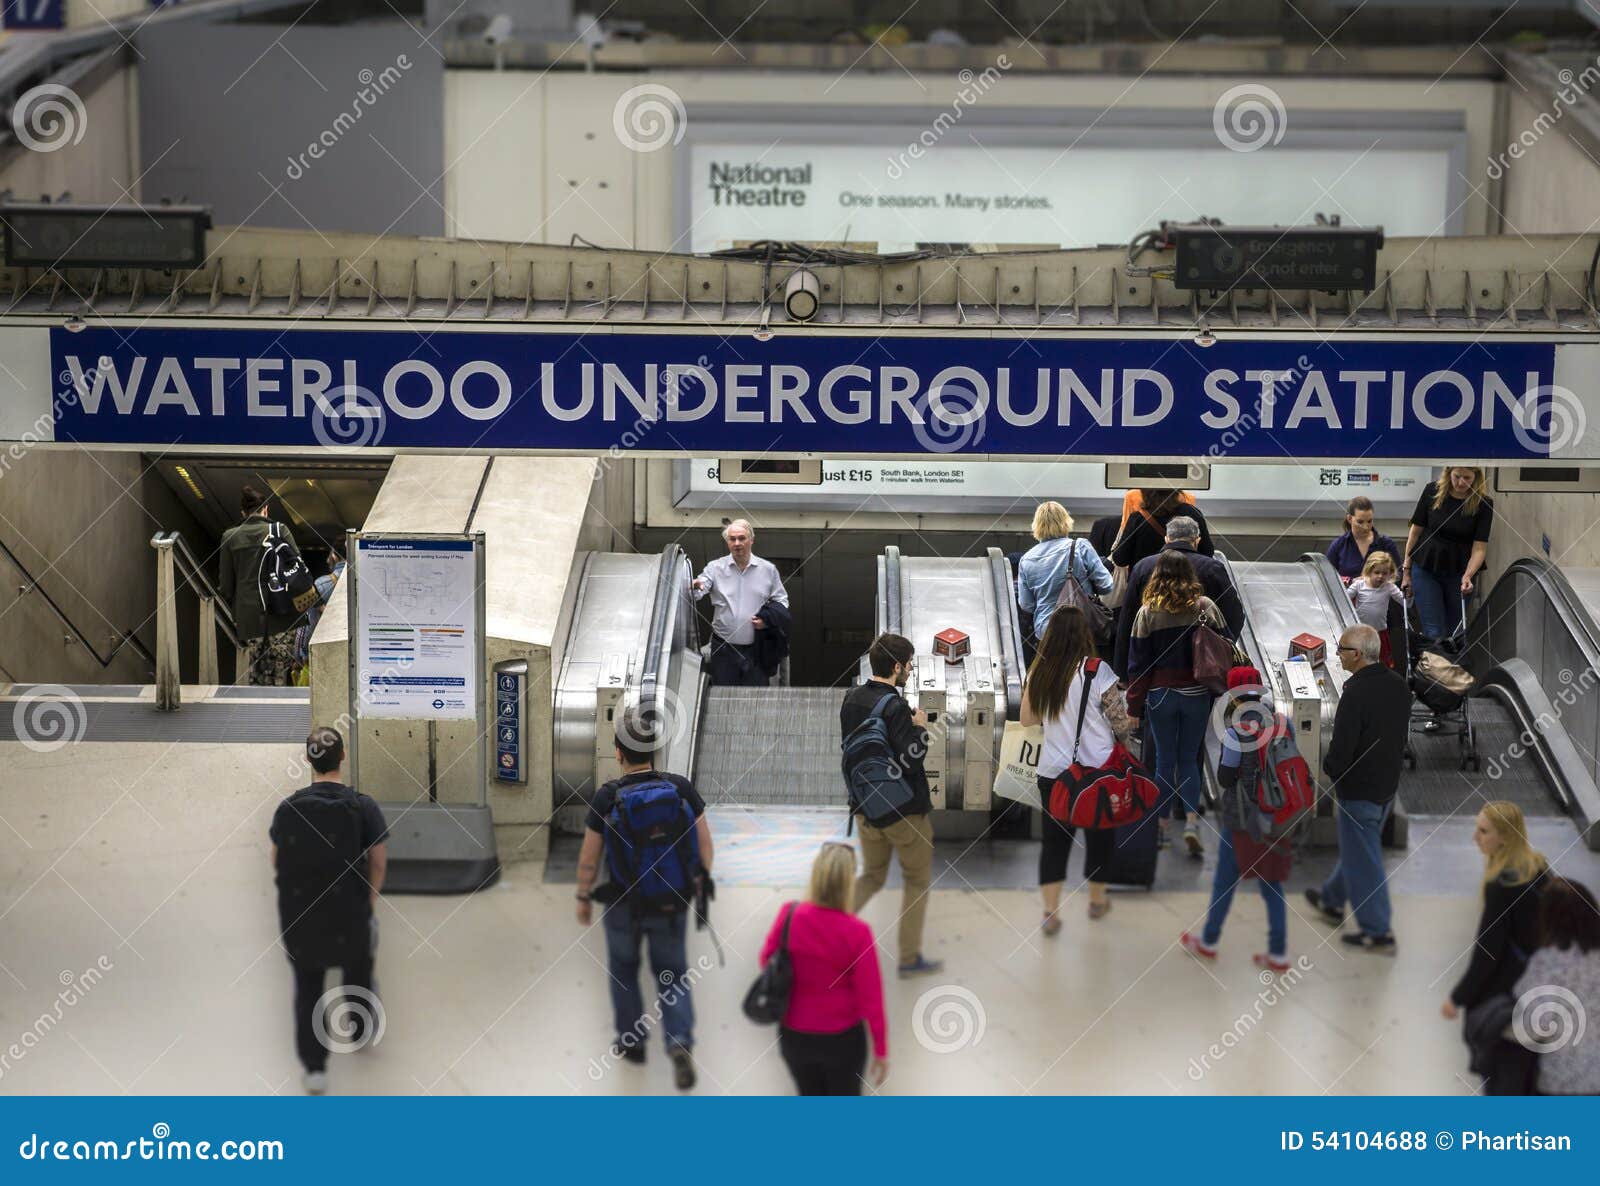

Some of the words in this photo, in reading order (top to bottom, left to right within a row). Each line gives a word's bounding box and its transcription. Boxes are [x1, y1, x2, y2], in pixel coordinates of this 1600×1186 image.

[709, 160, 812, 186] National
[709, 183, 806, 207] Theatre
[838, 191, 873, 207] One
[877, 192, 939, 208] season.
[945, 193, 989, 212] Many
[994, 194, 1053, 210] stories.
[64, 355, 512, 420] WATERLOO
[541, 362, 1174, 429] UNDERGROUND
[1200, 368, 1539, 430] STATION
[823, 470, 846, 482] ust
[849, 469, 873, 482] £15
[902, 469, 922, 477] Bank,
[1319, 472, 1342, 486] £15
[931, 784, 939, 795] 4
